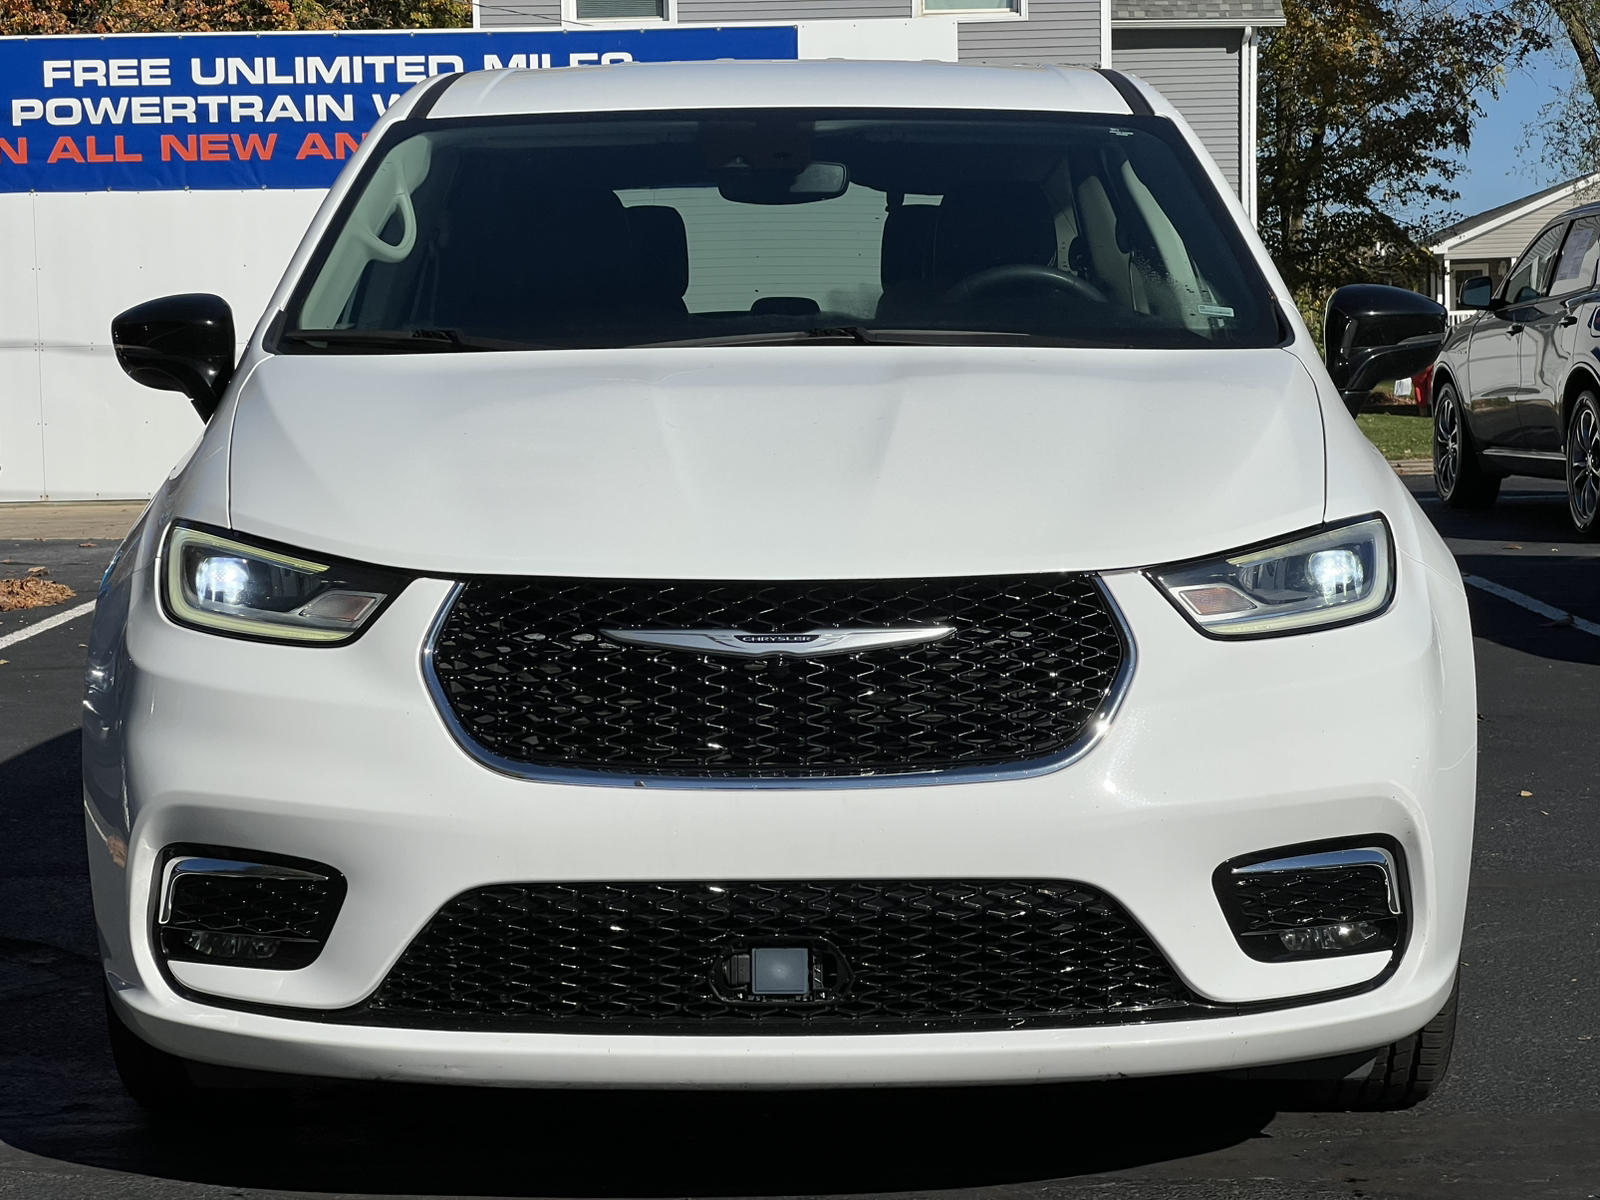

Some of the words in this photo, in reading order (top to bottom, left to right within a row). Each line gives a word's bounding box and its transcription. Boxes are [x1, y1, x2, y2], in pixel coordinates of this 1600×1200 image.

[43, 58, 172, 88] FREE
[190, 55, 464, 86] UNLIMITED
[12, 94, 354, 127] POWERTRAIN
[47, 135, 143, 164] ALL
[160, 133, 278, 162] NEW
